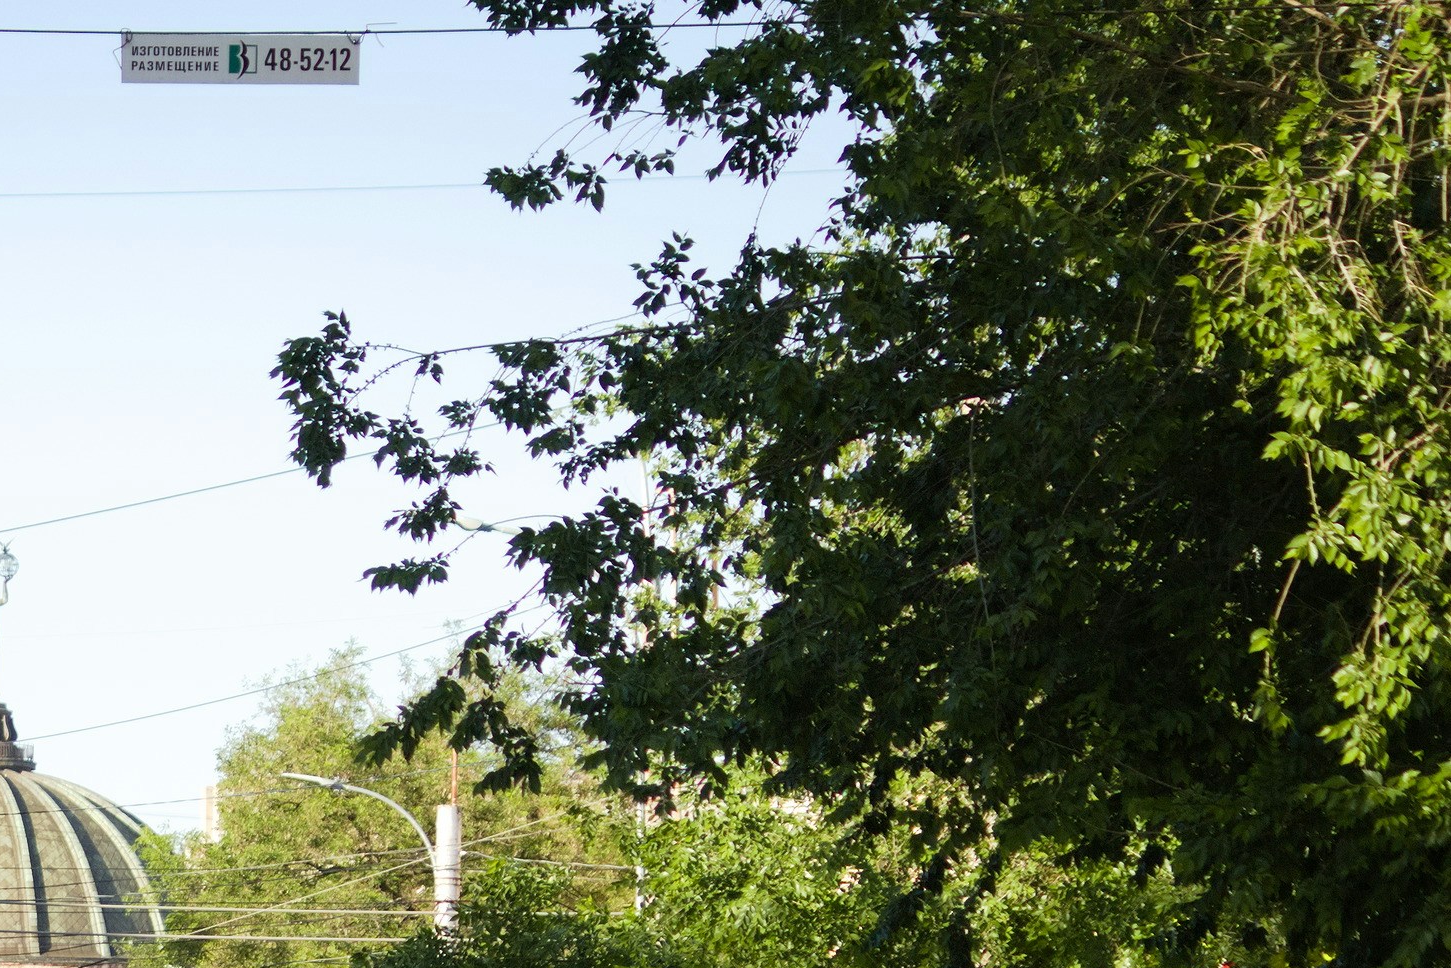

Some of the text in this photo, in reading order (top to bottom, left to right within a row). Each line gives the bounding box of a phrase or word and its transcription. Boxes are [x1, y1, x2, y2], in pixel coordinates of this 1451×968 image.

[131, 45, 220, 57] ИЗГОТОВЛЕНИЕ
[264, 47, 352, 72] 48-52-12
[131, 61, 220, 73] РАЗМЕЩЕНИЕ
